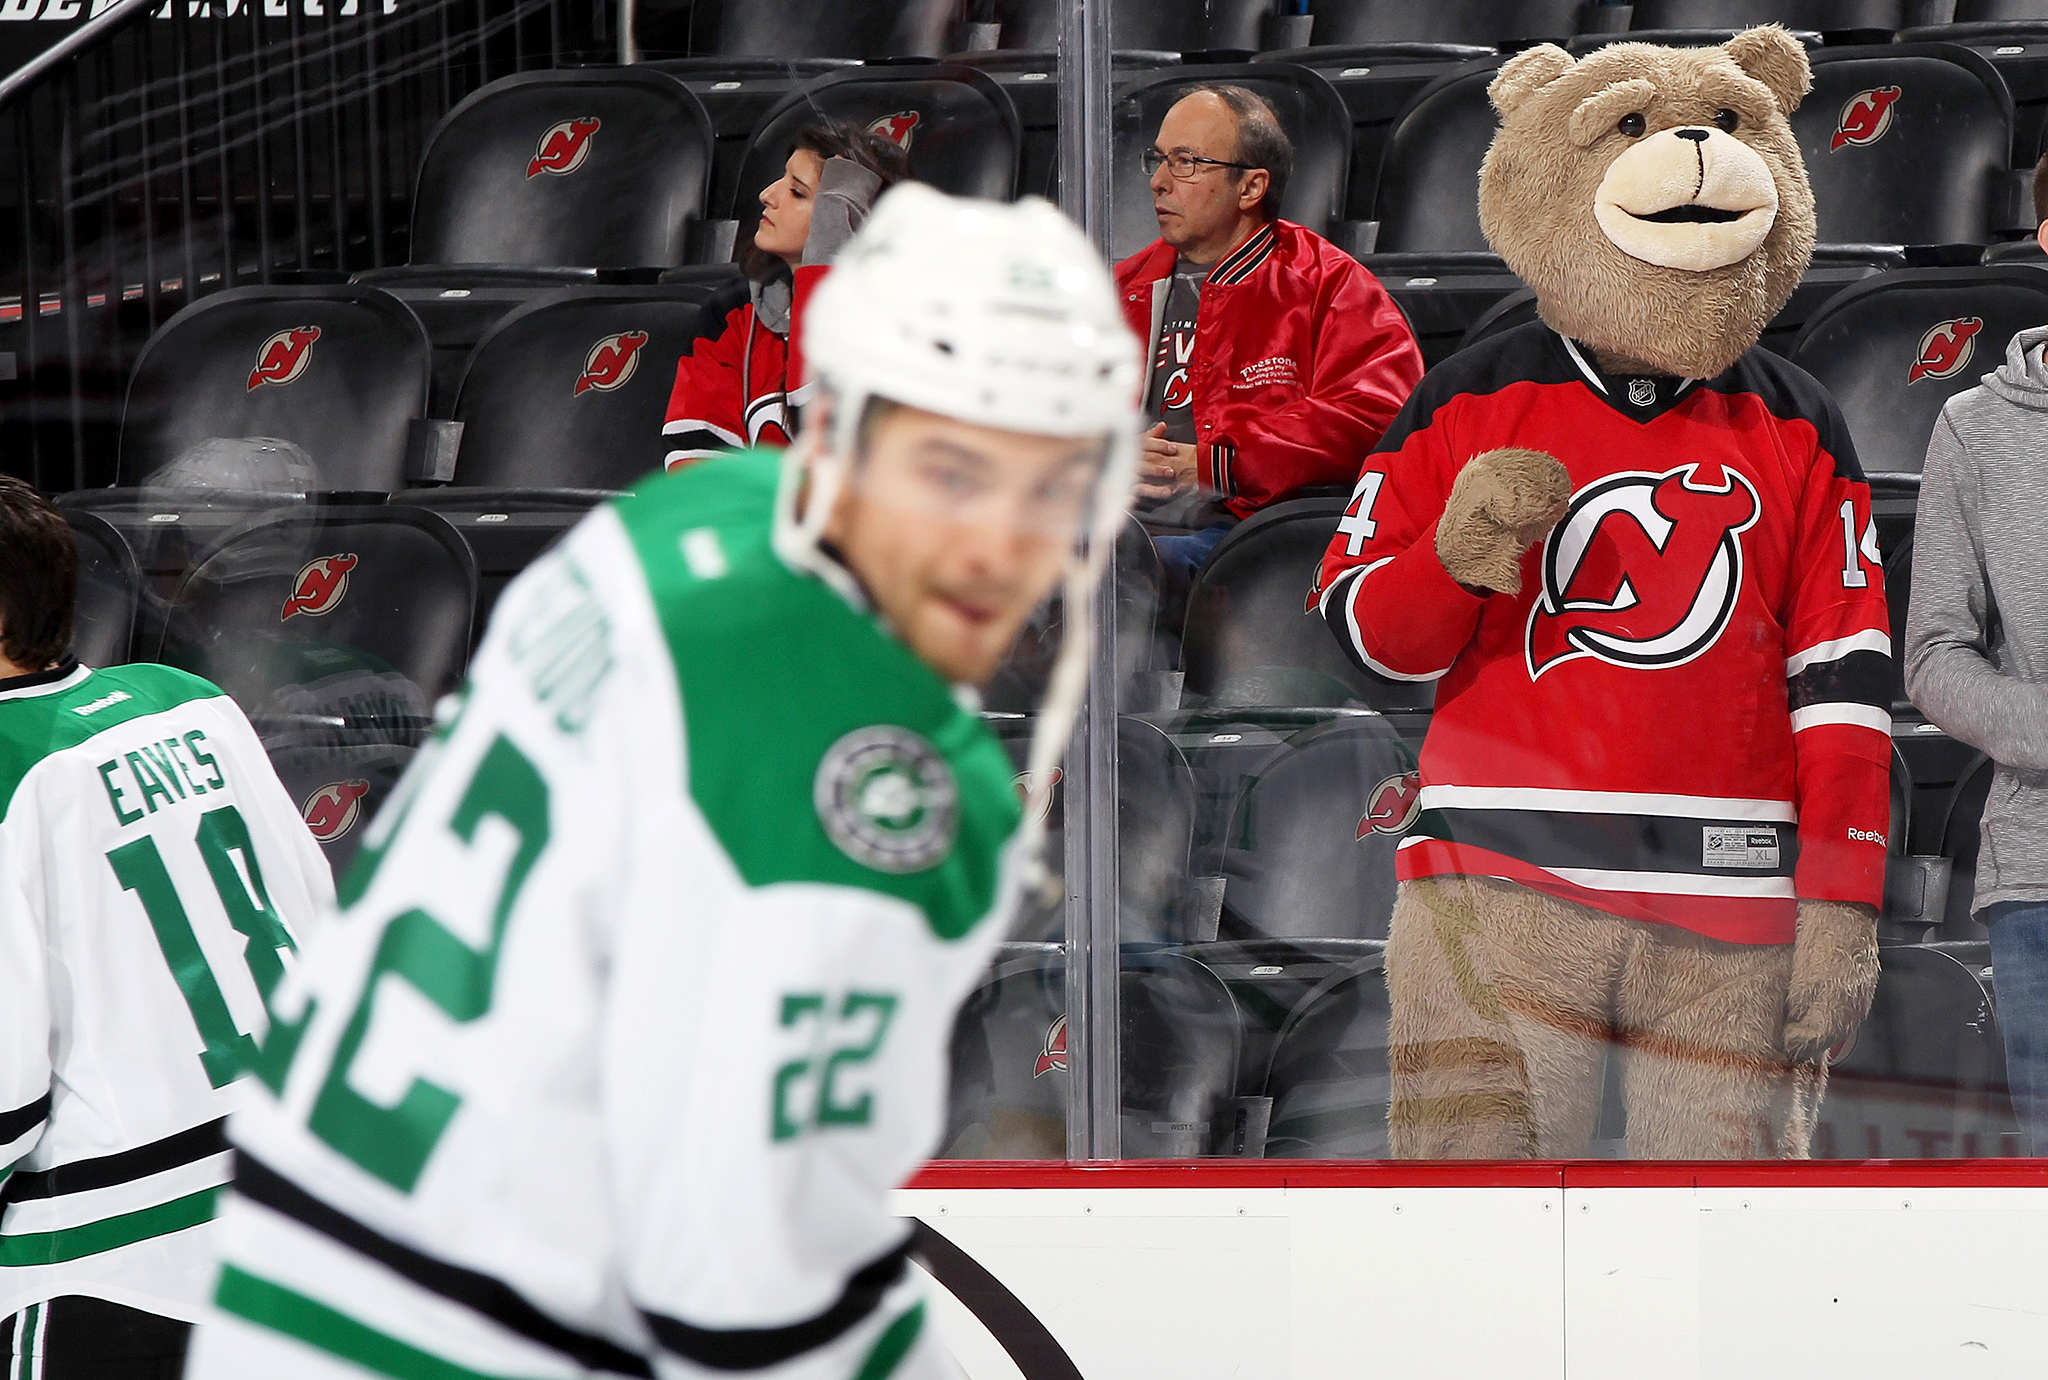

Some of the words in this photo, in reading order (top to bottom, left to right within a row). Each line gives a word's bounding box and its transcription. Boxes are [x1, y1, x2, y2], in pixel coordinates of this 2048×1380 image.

[97, 729, 225, 827] EAVES
[1755, 849, 1772, 861] XL
[771, 991, 900, 1142] 22
